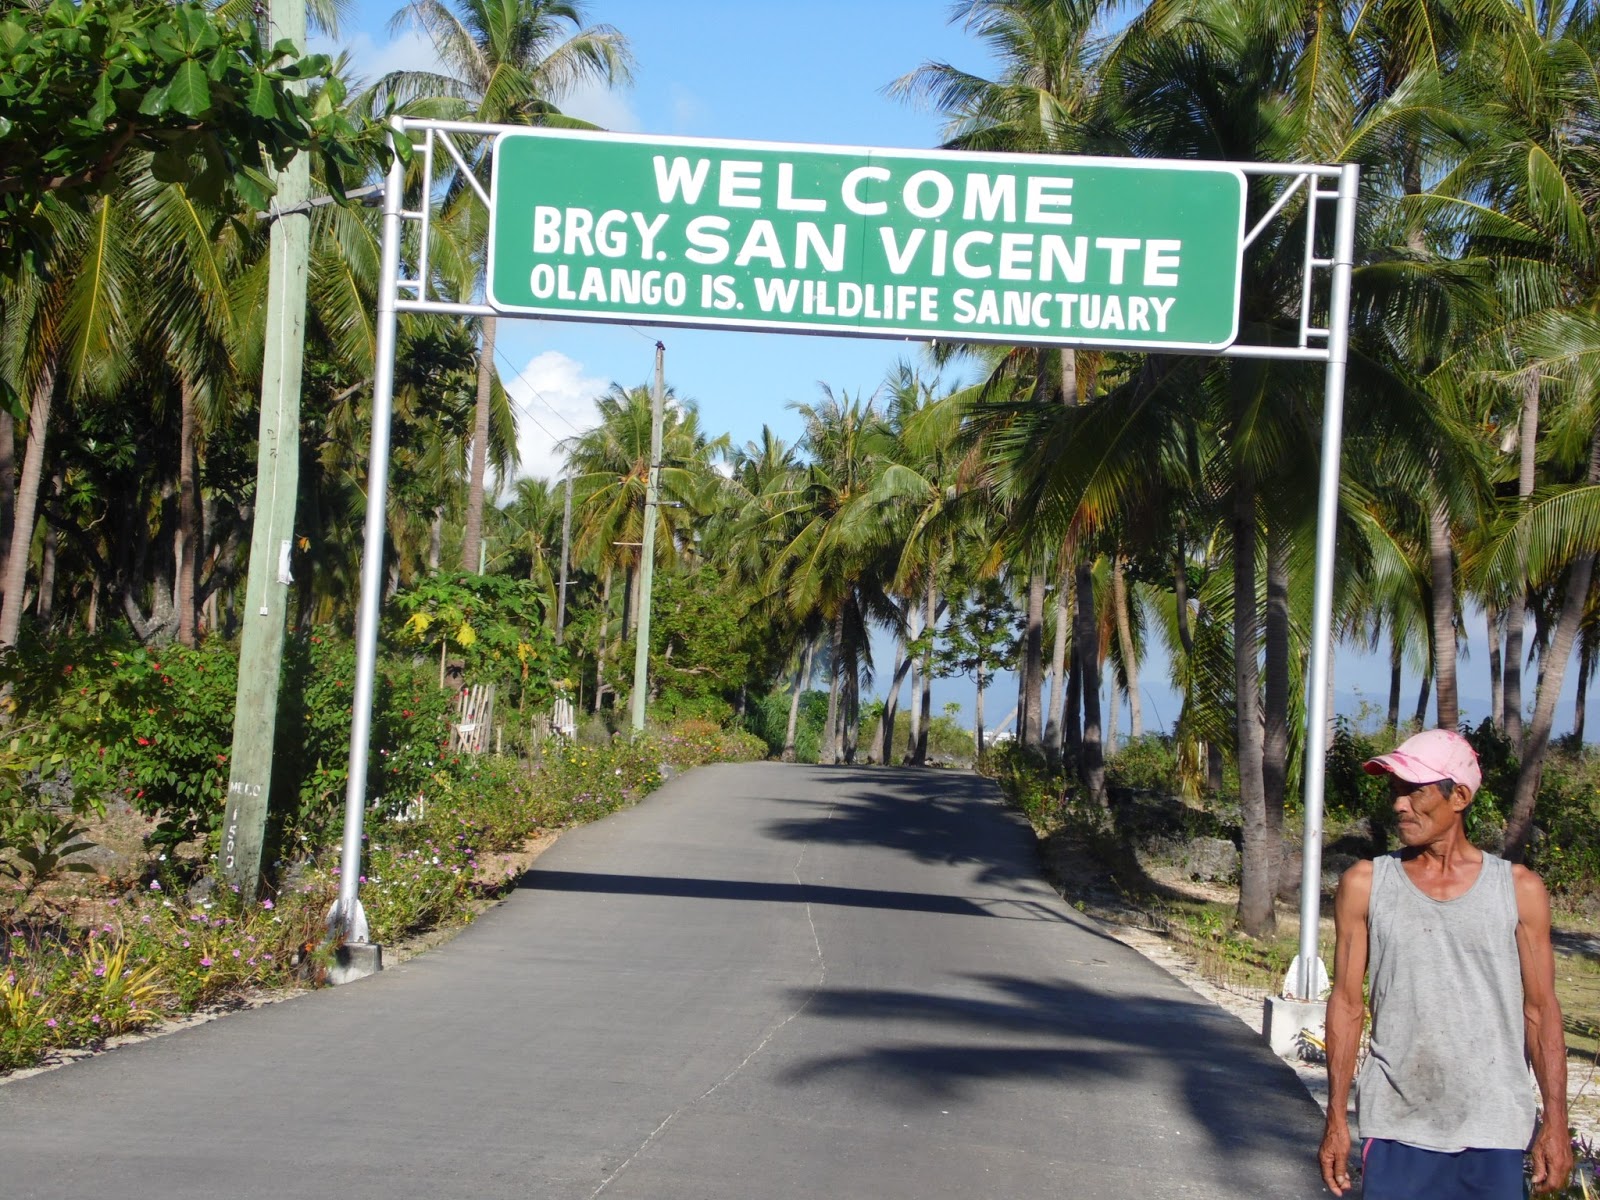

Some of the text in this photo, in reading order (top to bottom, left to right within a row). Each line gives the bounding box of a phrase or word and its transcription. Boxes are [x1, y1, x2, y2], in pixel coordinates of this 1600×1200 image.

[652, 155, 1074, 225] WELCOME
[533, 205, 1182, 287] BRGY. SAN VICENTE
[530, 263, 1177, 333] OLANGO IS. WILDLIFE SANCTUARY
